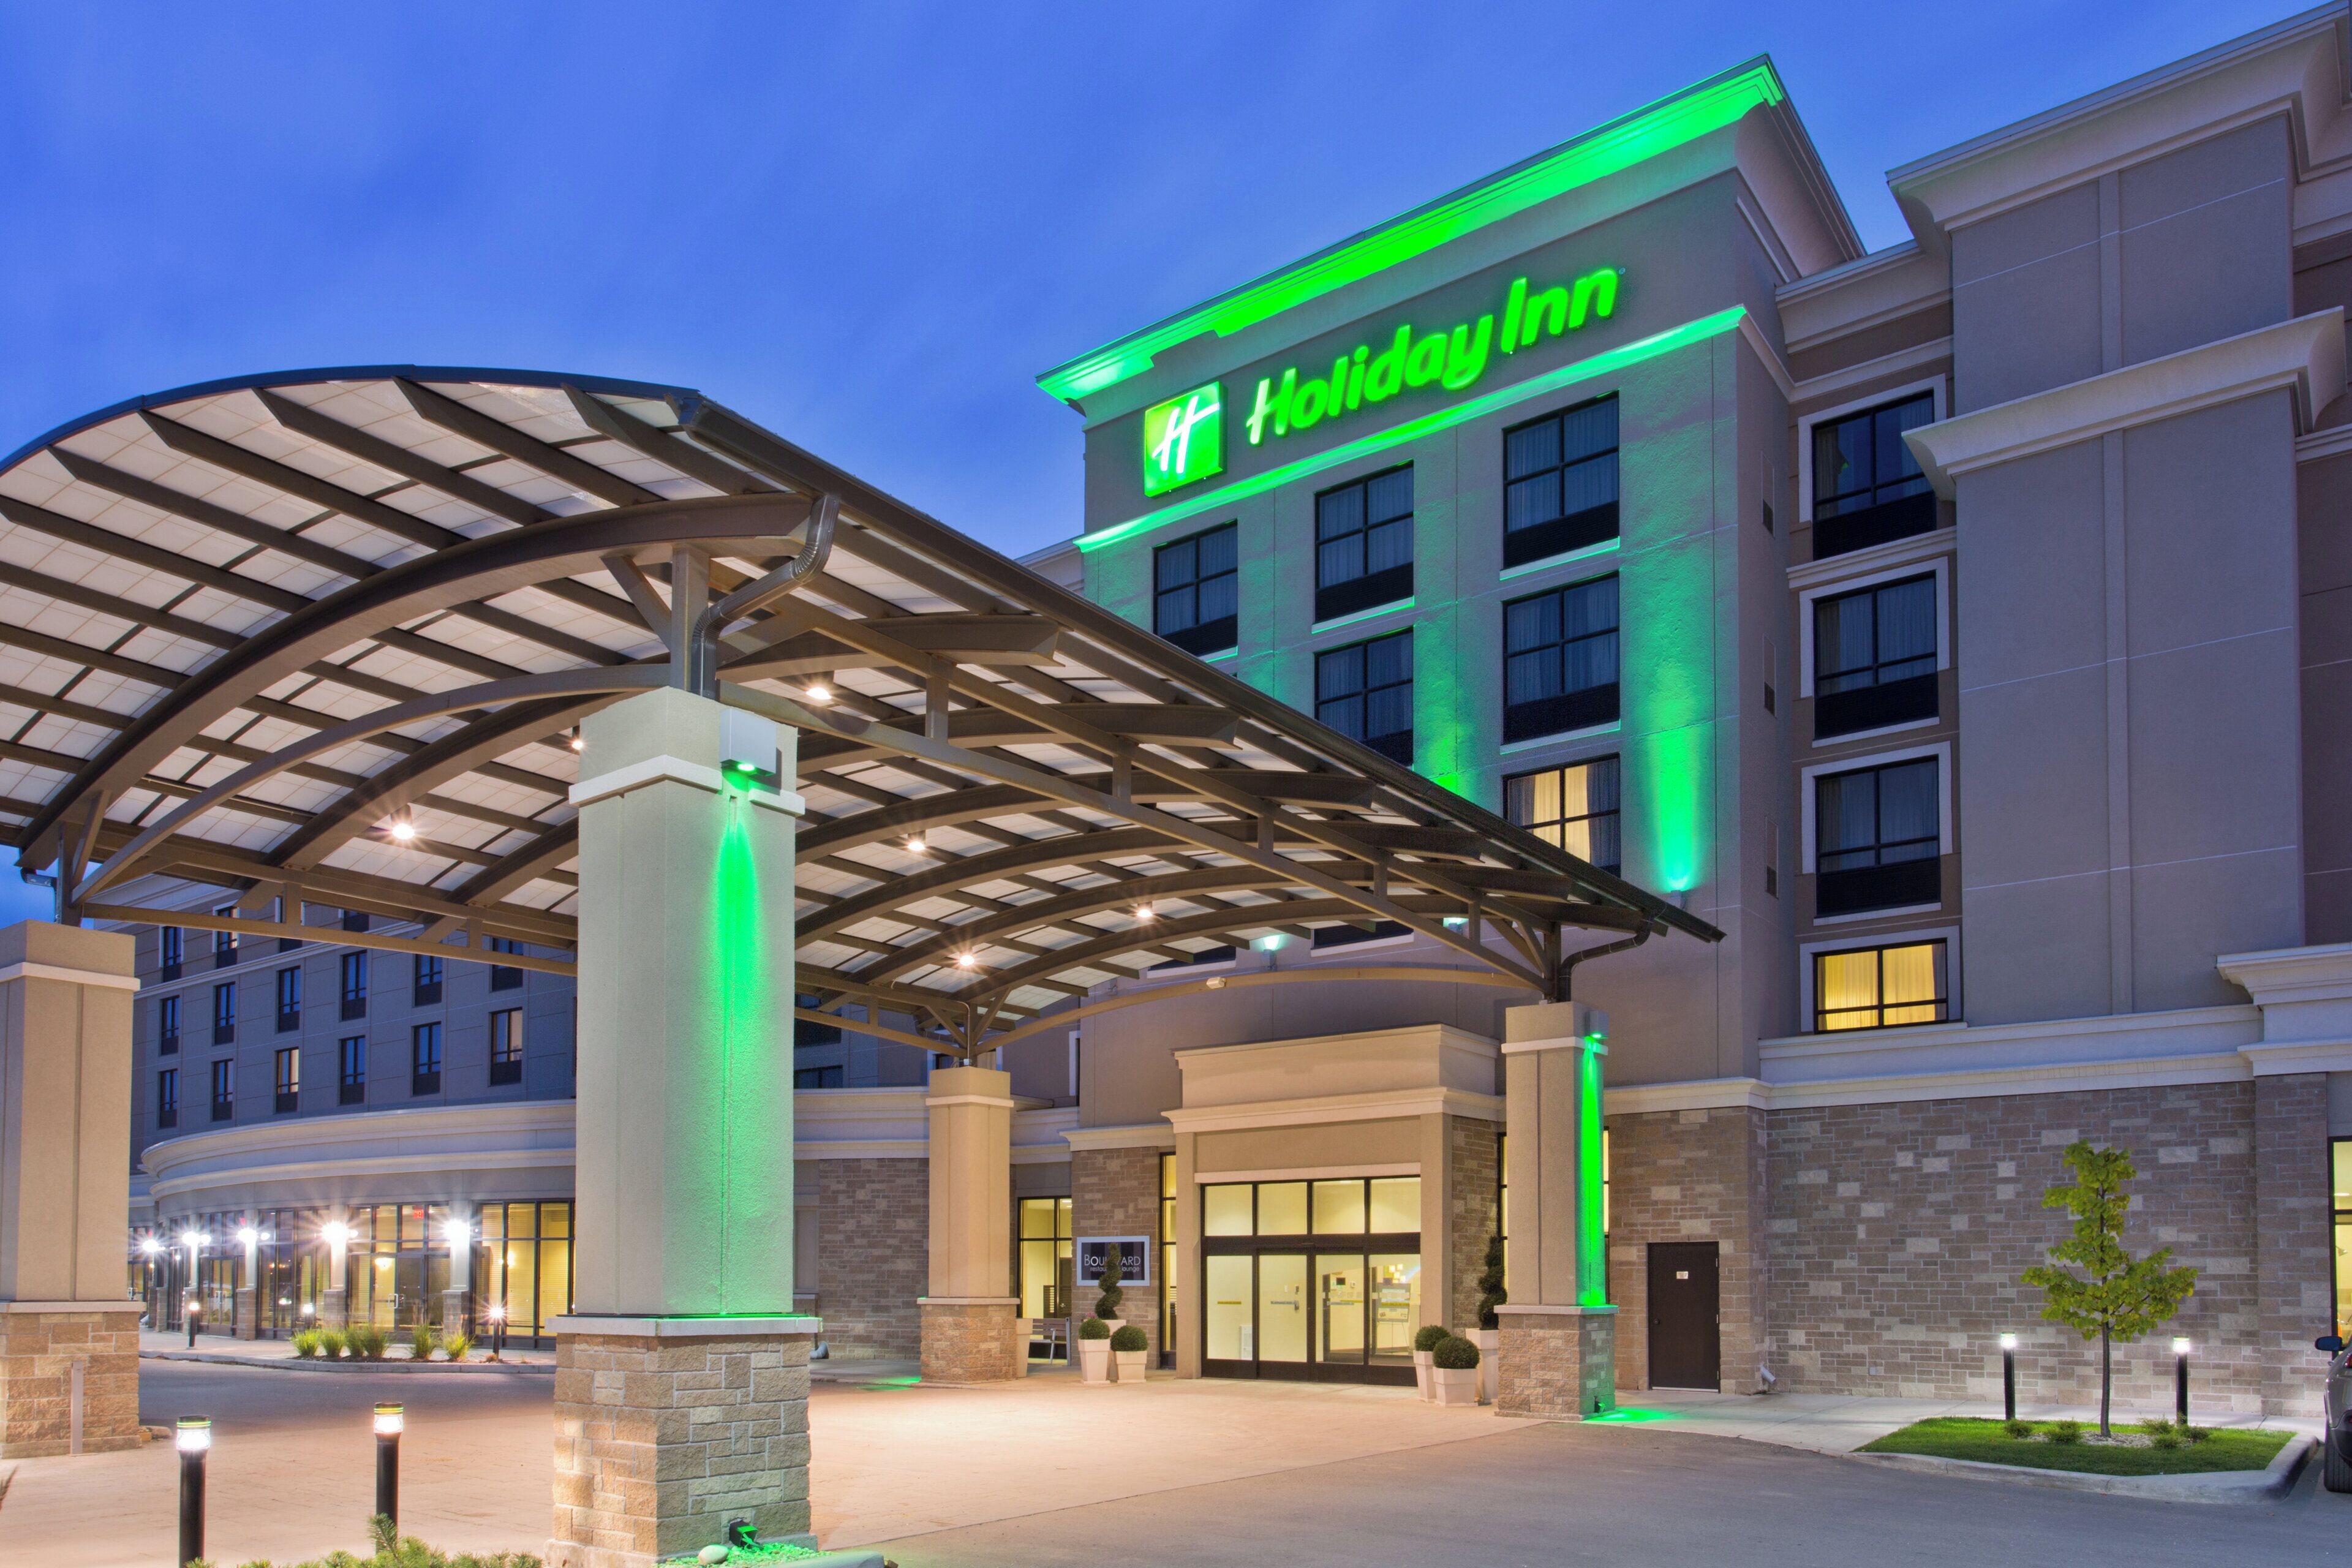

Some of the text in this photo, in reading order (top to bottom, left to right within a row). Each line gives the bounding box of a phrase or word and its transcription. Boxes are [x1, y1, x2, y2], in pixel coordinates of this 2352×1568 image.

[1246, 268, 1618, 445] Holiday Inn
[1084, 1254, 1141, 1266] BOUARD
